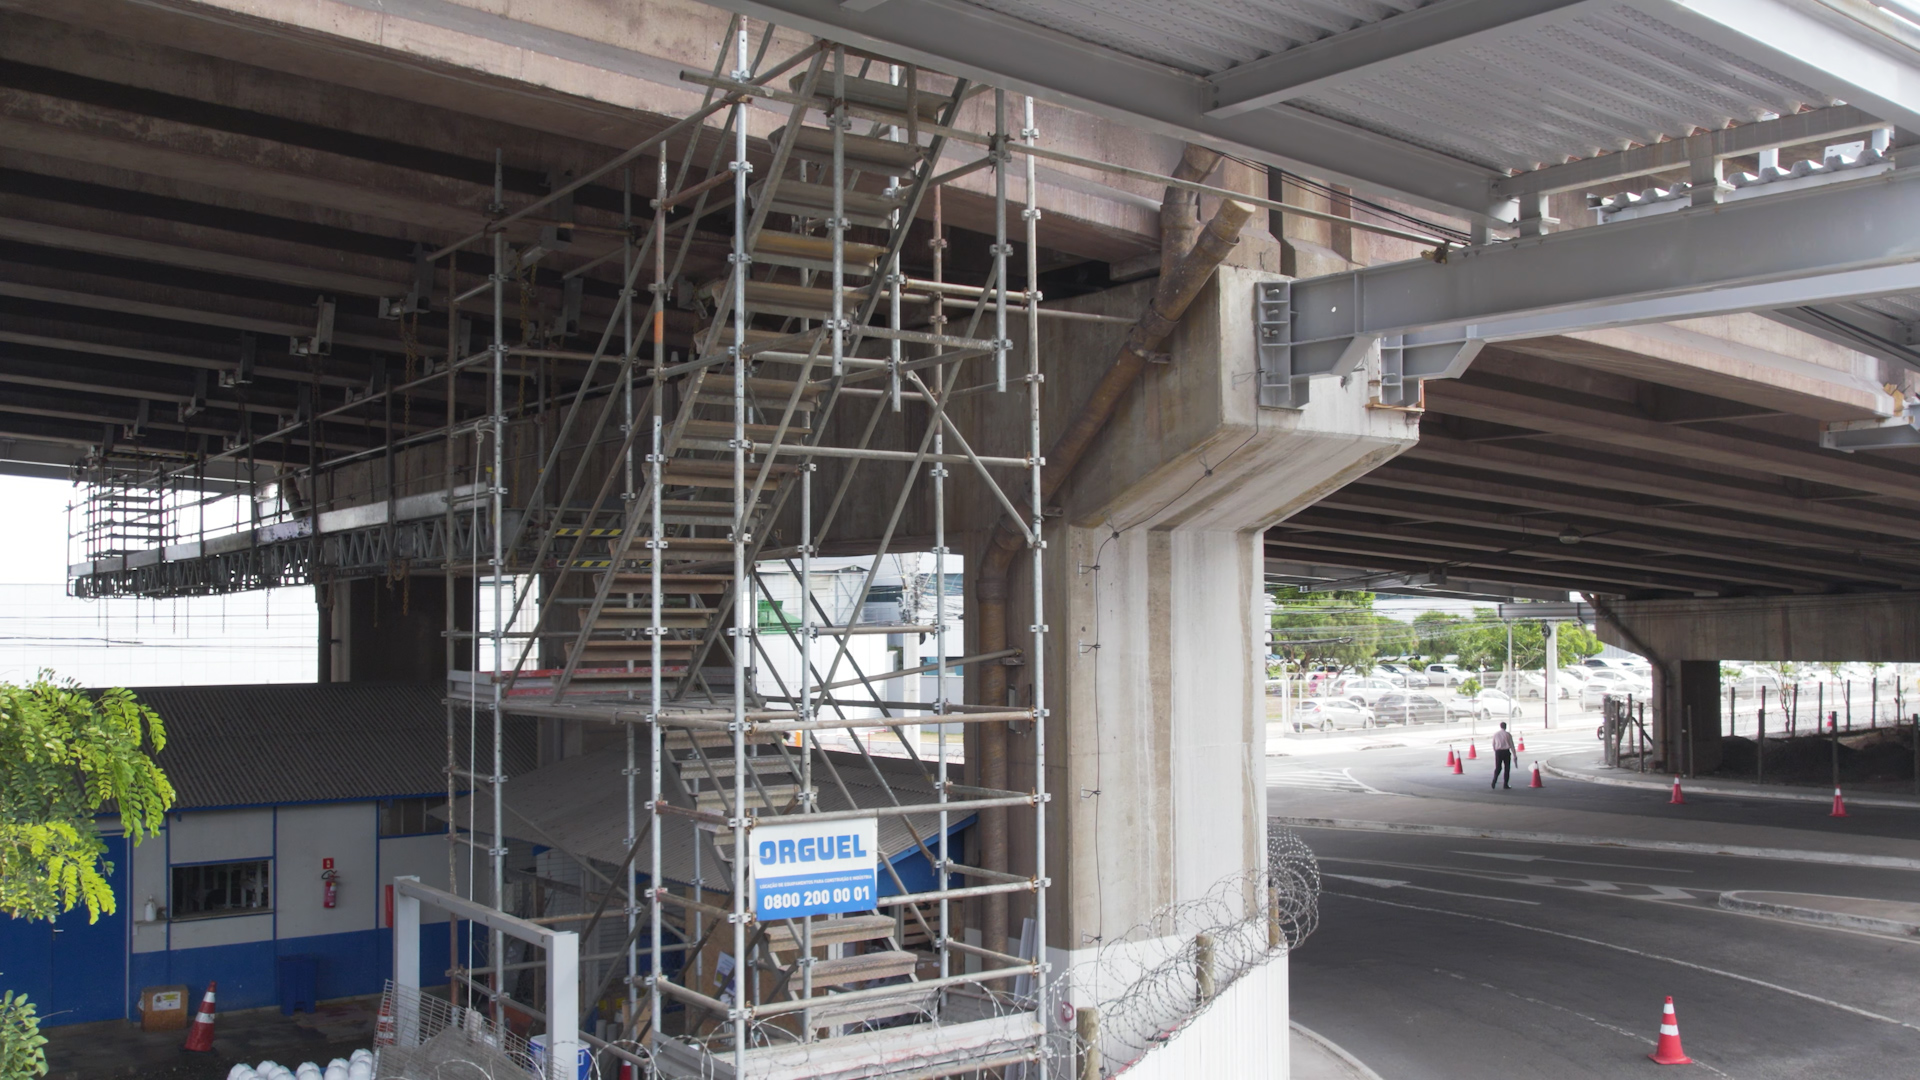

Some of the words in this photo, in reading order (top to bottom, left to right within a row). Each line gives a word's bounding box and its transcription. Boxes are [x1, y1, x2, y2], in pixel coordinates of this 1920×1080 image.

[759, 834, 867, 866] ORGUEL
[763, 892, 800, 910] 0800
[803, 890, 830, 906] 200
[833, 887, 850, 903] 00
[853, 885, 869, 902] 01
